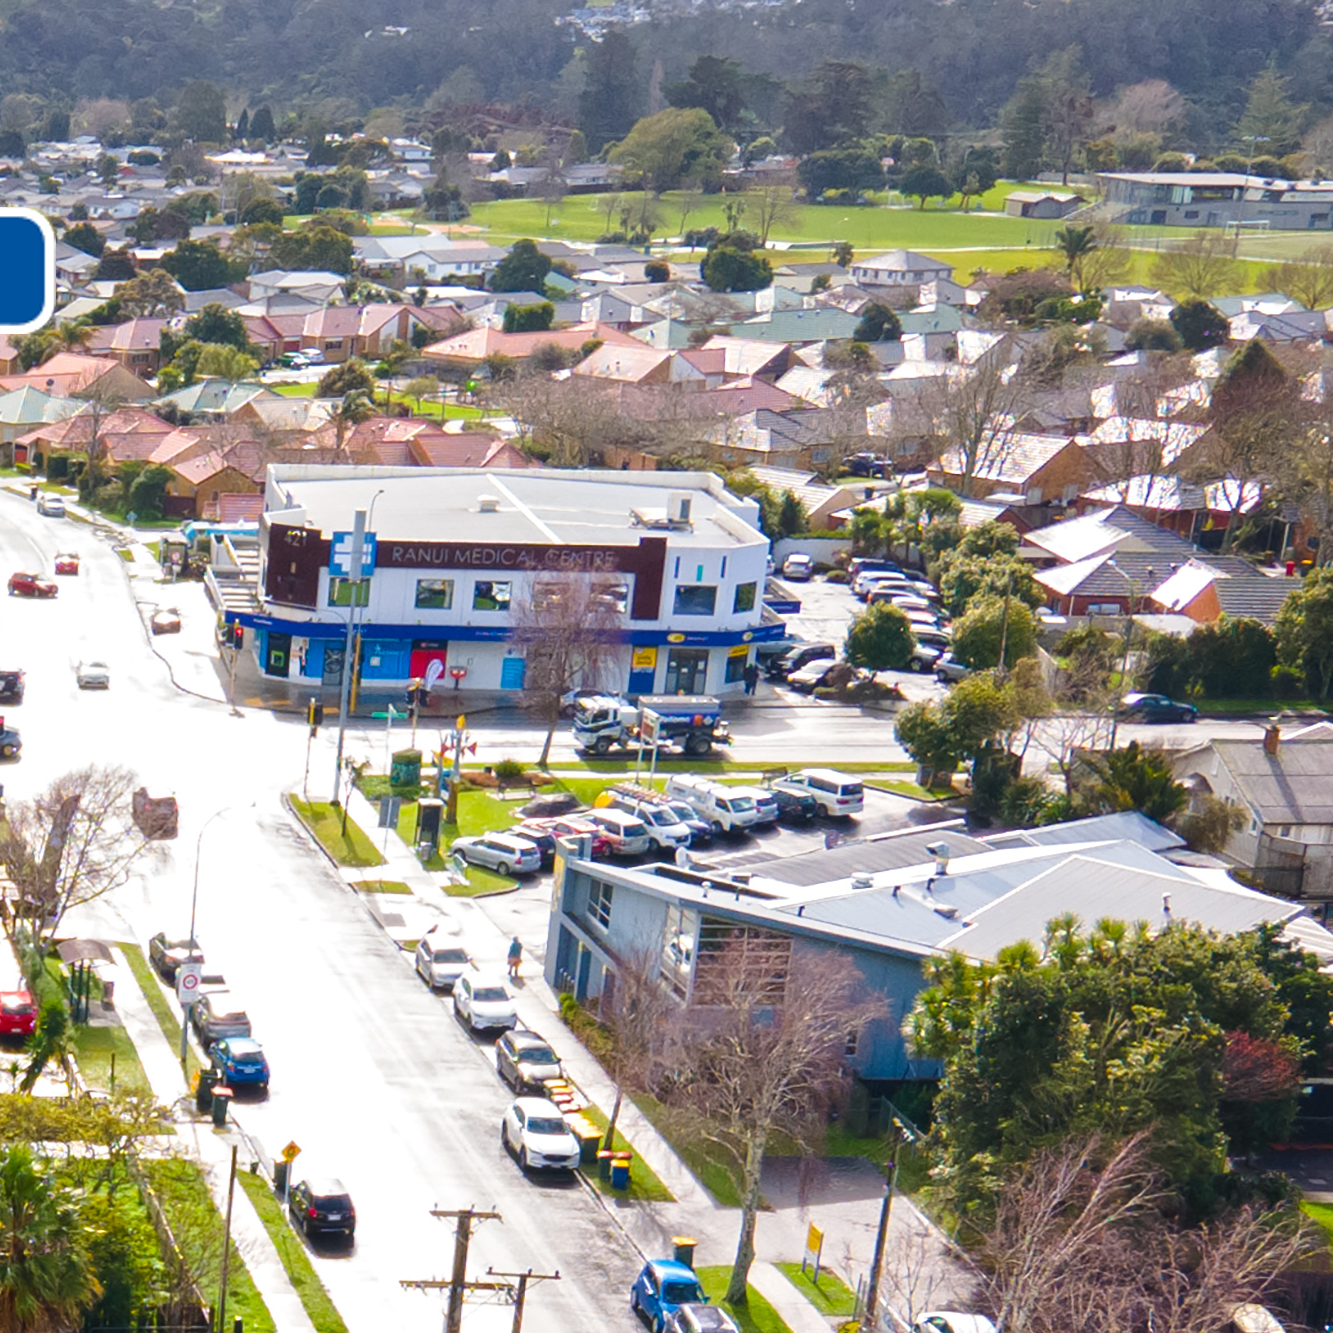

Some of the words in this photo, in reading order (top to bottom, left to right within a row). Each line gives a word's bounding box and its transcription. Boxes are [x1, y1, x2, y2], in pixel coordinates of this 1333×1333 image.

[283, 531, 307, 547] 421
[392, 546, 449, 563] RANUI
[454, 548, 535, 566] MEDICAL
[545, 549, 615, 567] CENTRE
